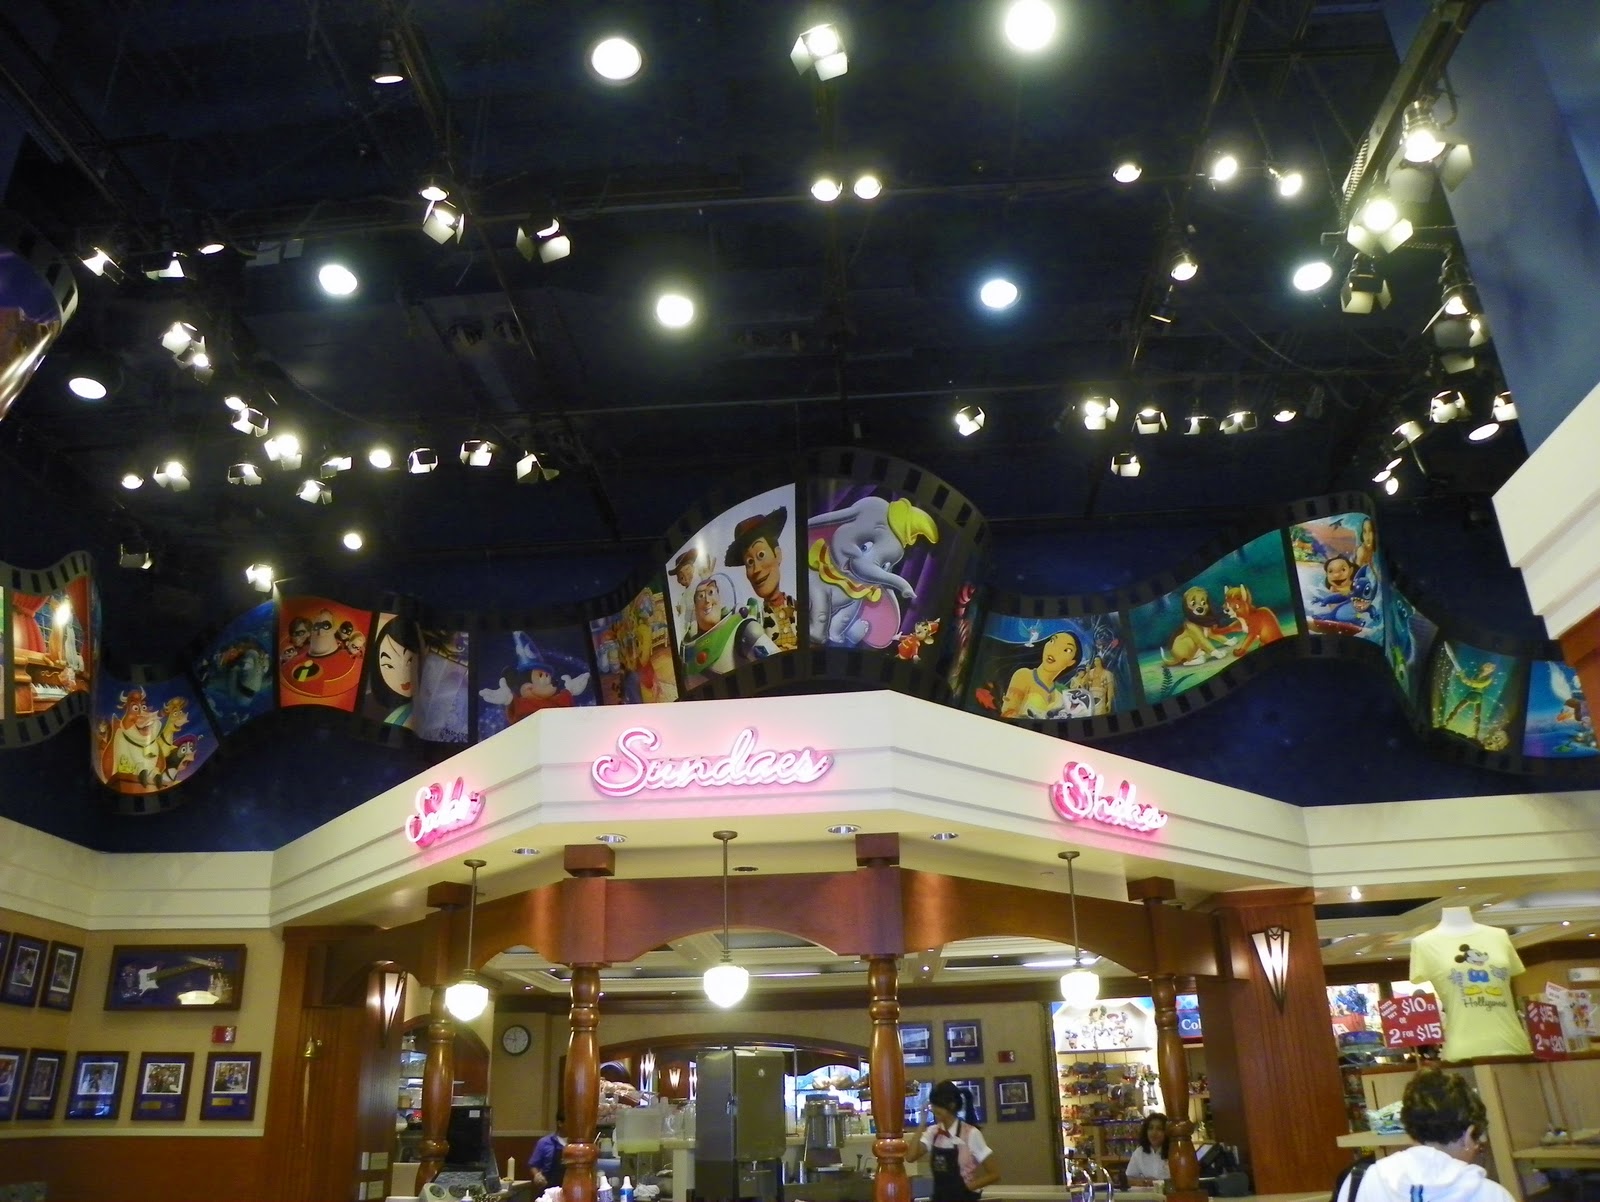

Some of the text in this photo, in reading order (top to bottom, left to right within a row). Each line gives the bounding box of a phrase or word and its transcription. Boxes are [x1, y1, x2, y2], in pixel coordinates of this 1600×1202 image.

[591, 727, 834, 797] Sundaes
[1401, 997, 1427, 1015] $10
[1389, 1028, 1403, 1044] 2
[1416, 1022, 1442, 1042] $15
[1535, 1033, 1545, 1050] 2
